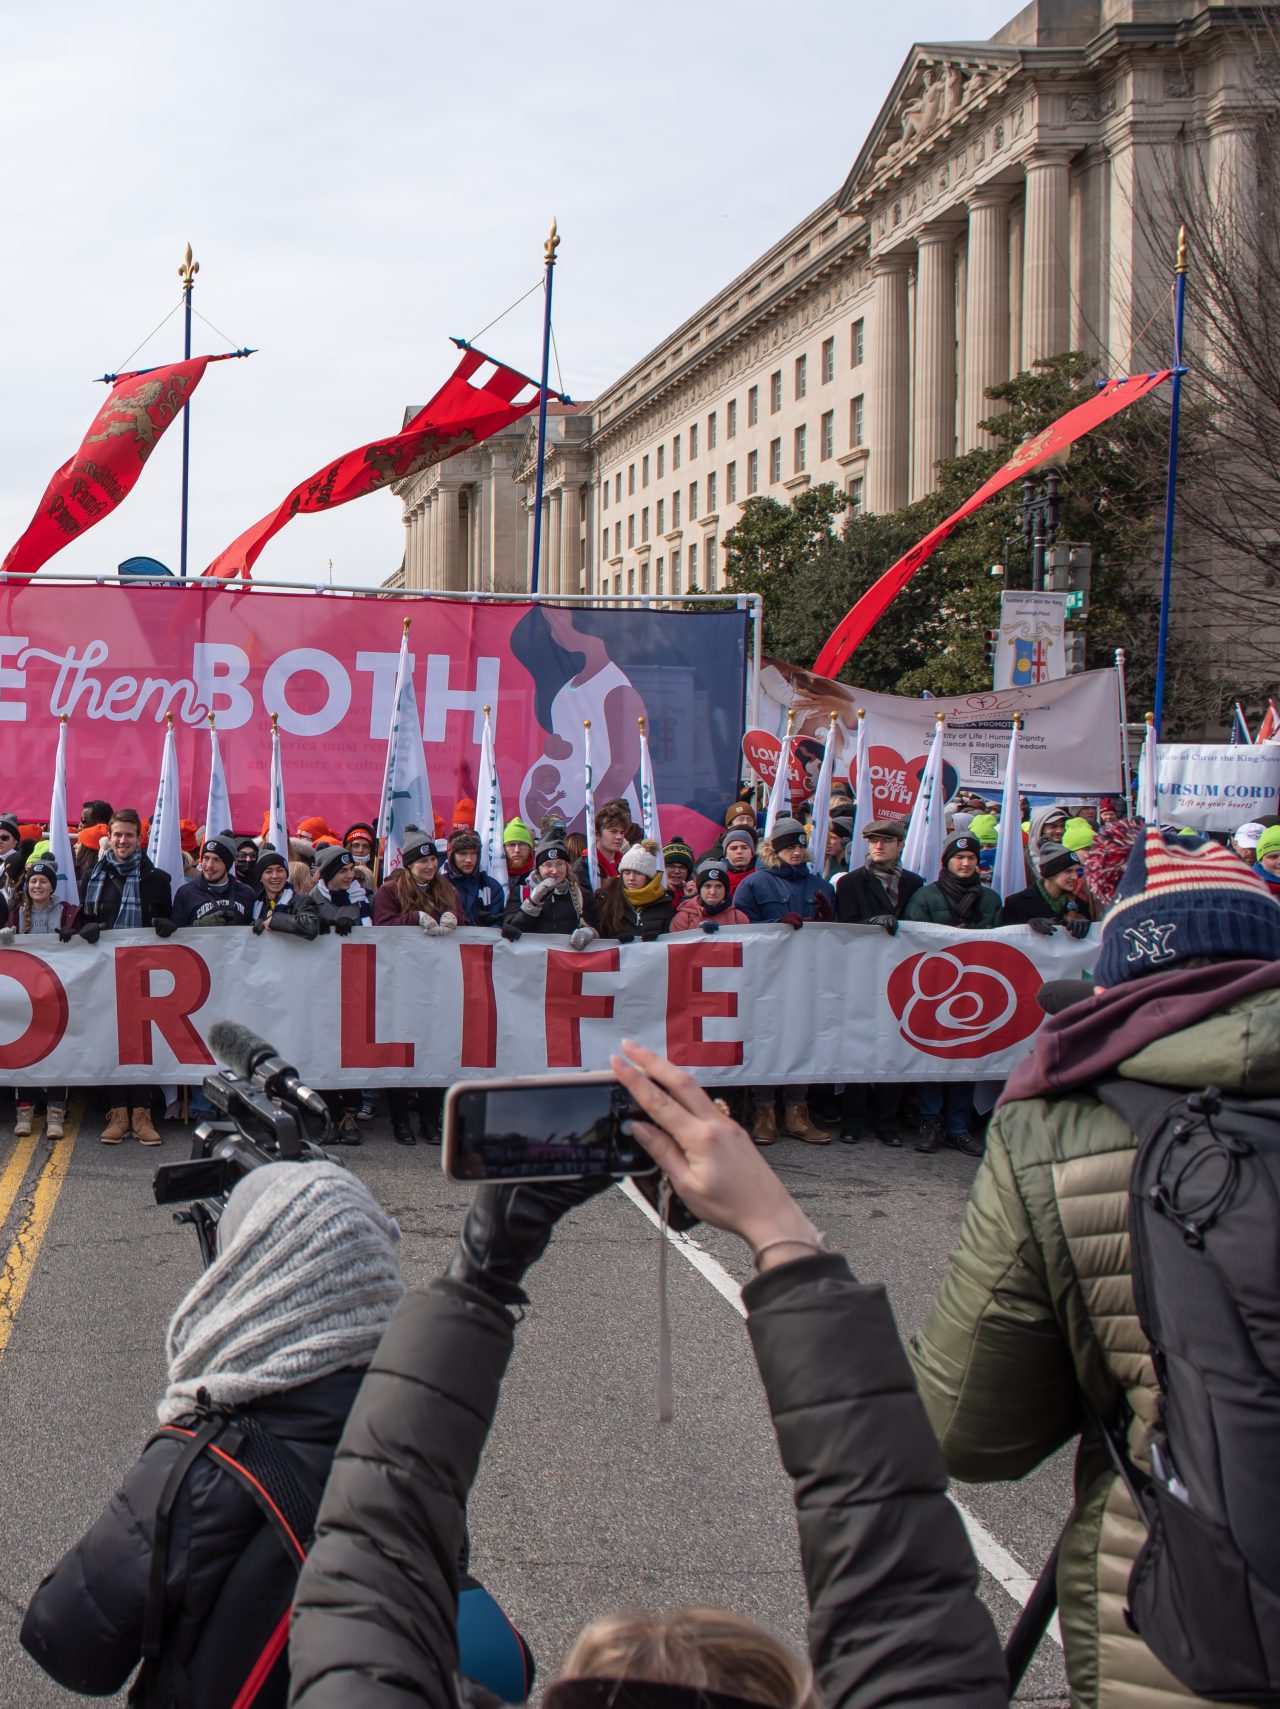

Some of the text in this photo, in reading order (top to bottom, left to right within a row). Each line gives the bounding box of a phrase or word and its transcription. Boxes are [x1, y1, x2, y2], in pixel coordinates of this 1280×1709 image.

[17, 639, 213, 725] them
[193, 642, 500, 744] BOTH
[968, 732, 983, 740] Life
[1192, 753, 1218, 761] Christ
[1220, 754, 1234, 762] the
[1237, 754, 1259, 763] King
[1196, 801, 1206, 809] up
[1123, 919, 1176, 963] NY
[340, 941, 744, 1069] LIFE
